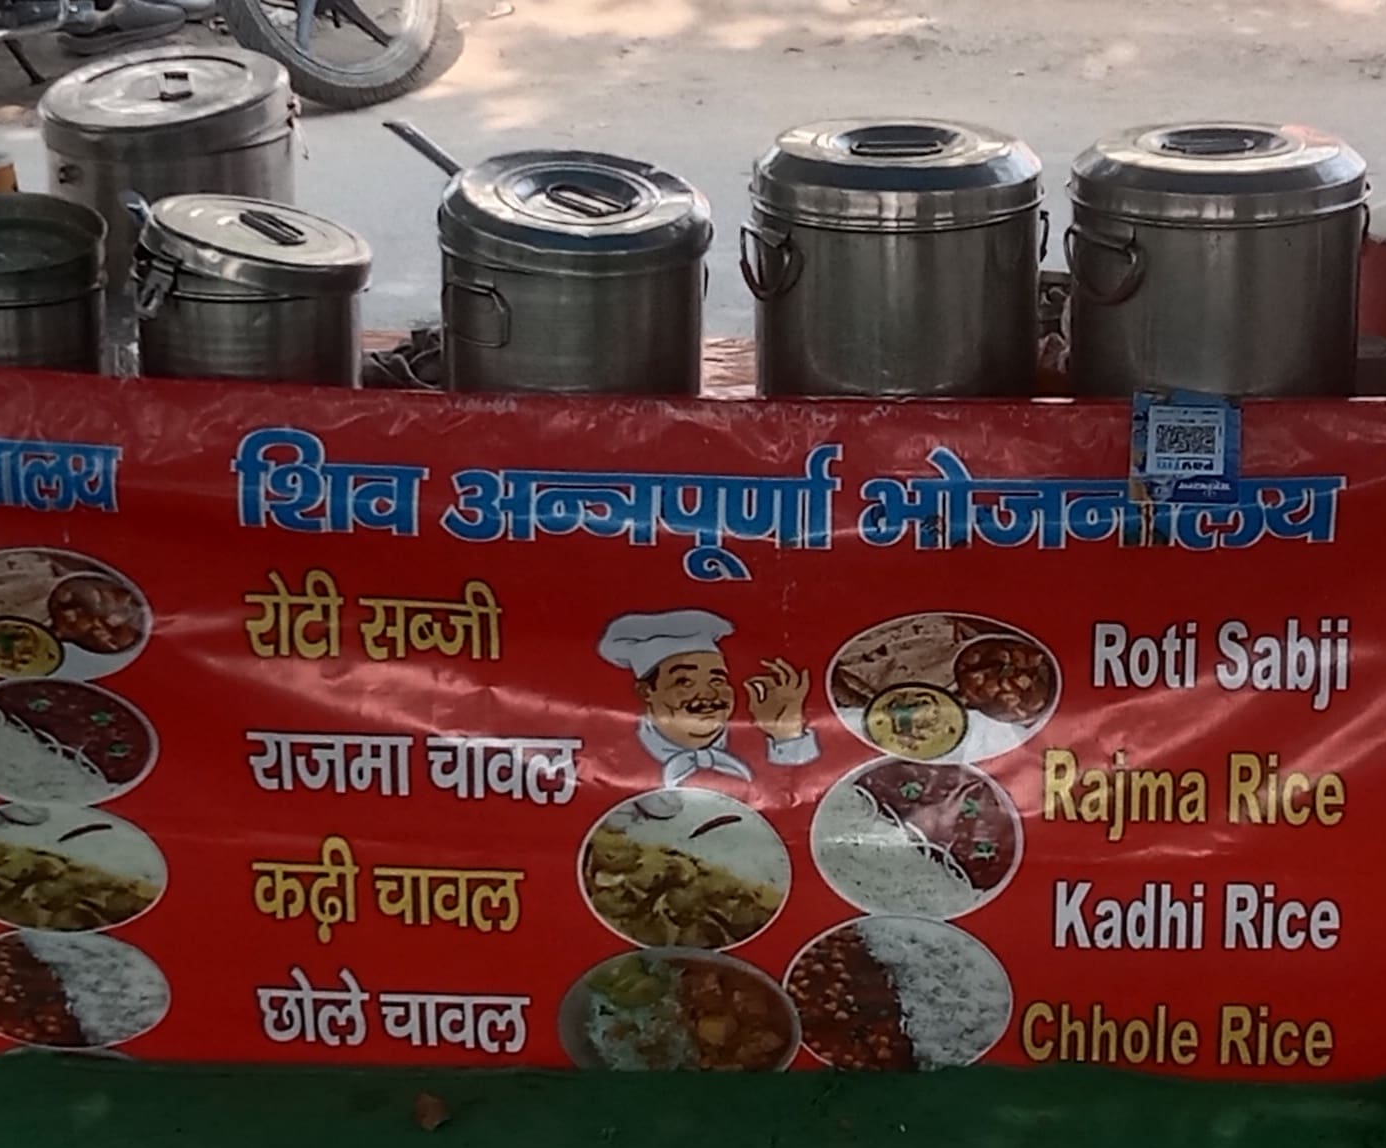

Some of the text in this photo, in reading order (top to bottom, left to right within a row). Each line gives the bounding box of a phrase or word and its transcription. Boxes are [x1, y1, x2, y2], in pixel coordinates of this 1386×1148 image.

[231, 427, 429, 537] शिव
[857, 446, 1347, 551] भोजनालय
[245, 569, 502, 662] रोटी सब्जी
[1093, 618, 1350, 711] Roti Sabji
[246, 731, 583, 805] राजमा चावल
[1043, 748, 1346, 841] Rajma Rice
[251, 835, 525, 945] कढ़ी चावल
[1055, 881, 1341, 950] Kadhi Rice
[256, 966, 531, 1055] छोले चावल
[1022, 1001, 1334, 1067] Chhole Rice
